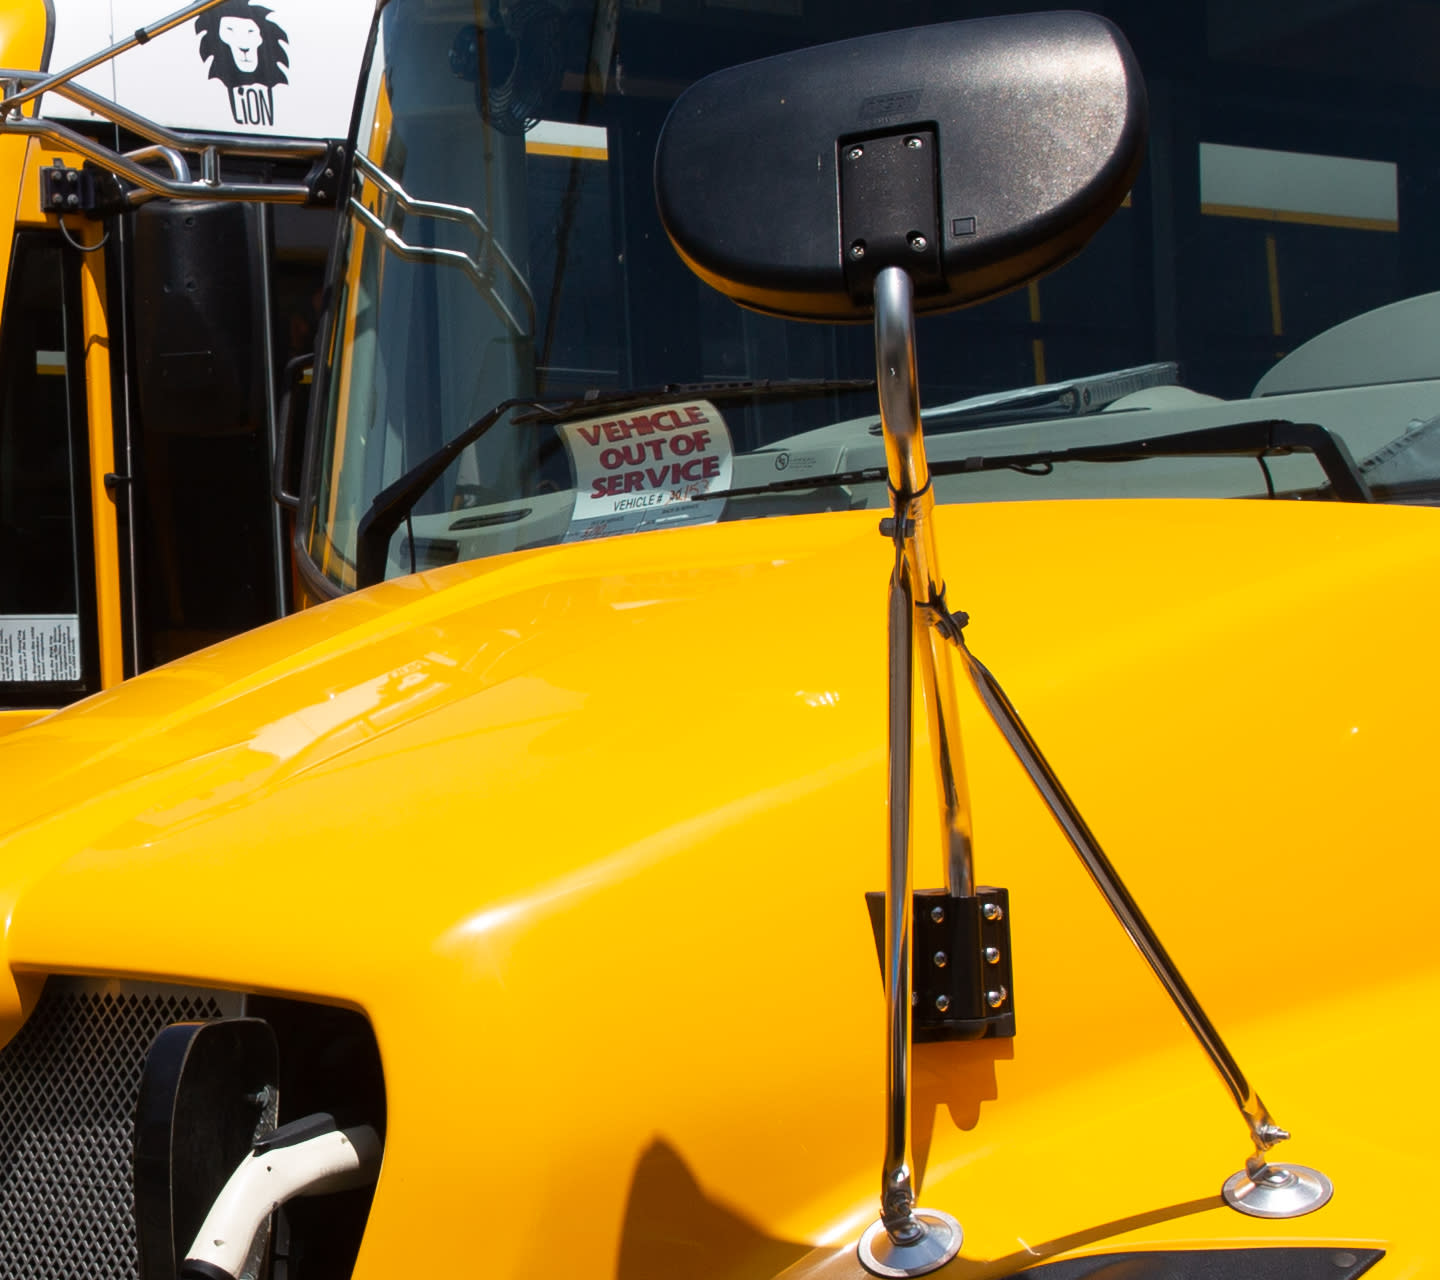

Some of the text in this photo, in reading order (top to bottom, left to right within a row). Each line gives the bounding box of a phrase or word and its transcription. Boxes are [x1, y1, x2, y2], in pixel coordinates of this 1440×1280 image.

[576, 406, 710, 447] VEHICLE
[599, 429, 712, 470] OUT OF
[590, 455, 721, 500] SERVICE
[613, 495, 656, 512] VEHICLE
